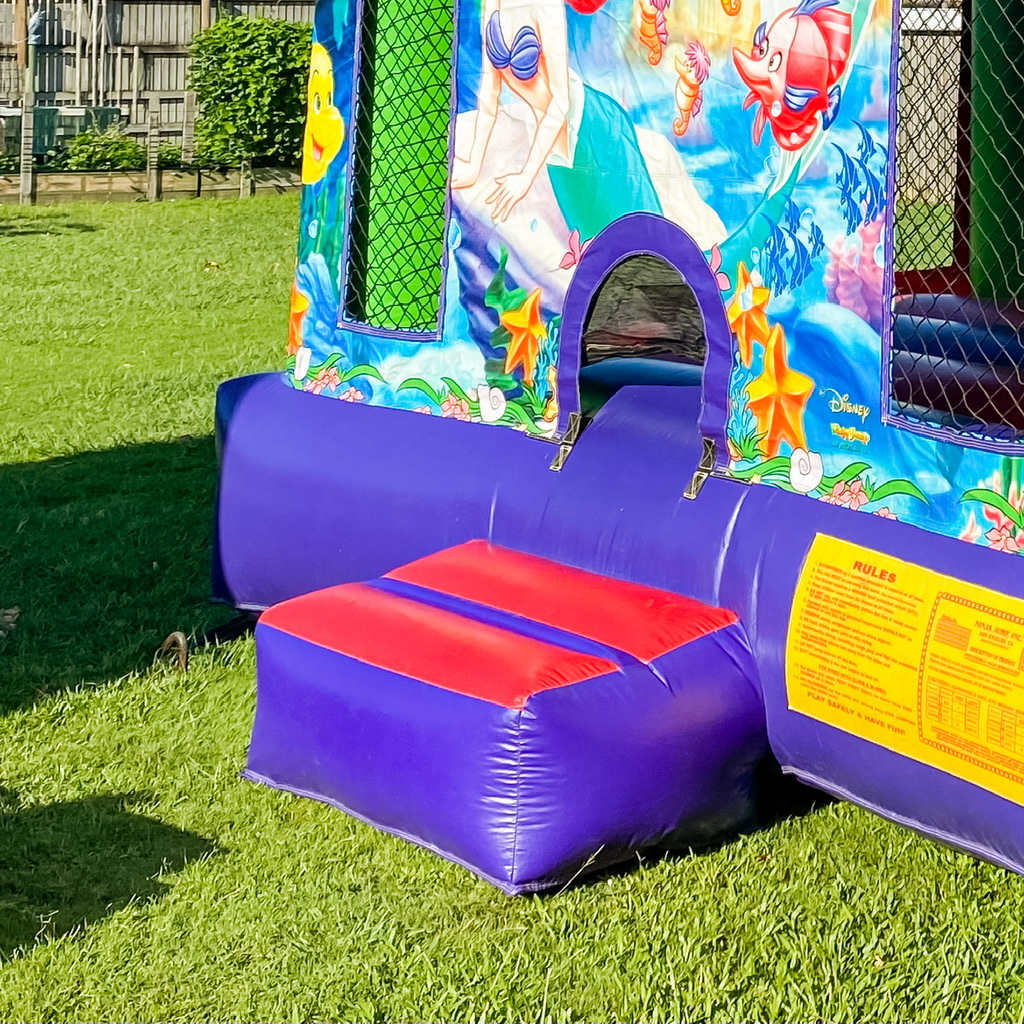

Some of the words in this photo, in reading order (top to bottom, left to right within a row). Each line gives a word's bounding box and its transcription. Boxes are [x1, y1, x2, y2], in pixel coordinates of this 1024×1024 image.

[852, 560, 897, 584] RULES
[807, 690, 826, 704] PLAY
[826, 698, 855, 716] SAFELY
[864, 715, 886, 729] HAVE
